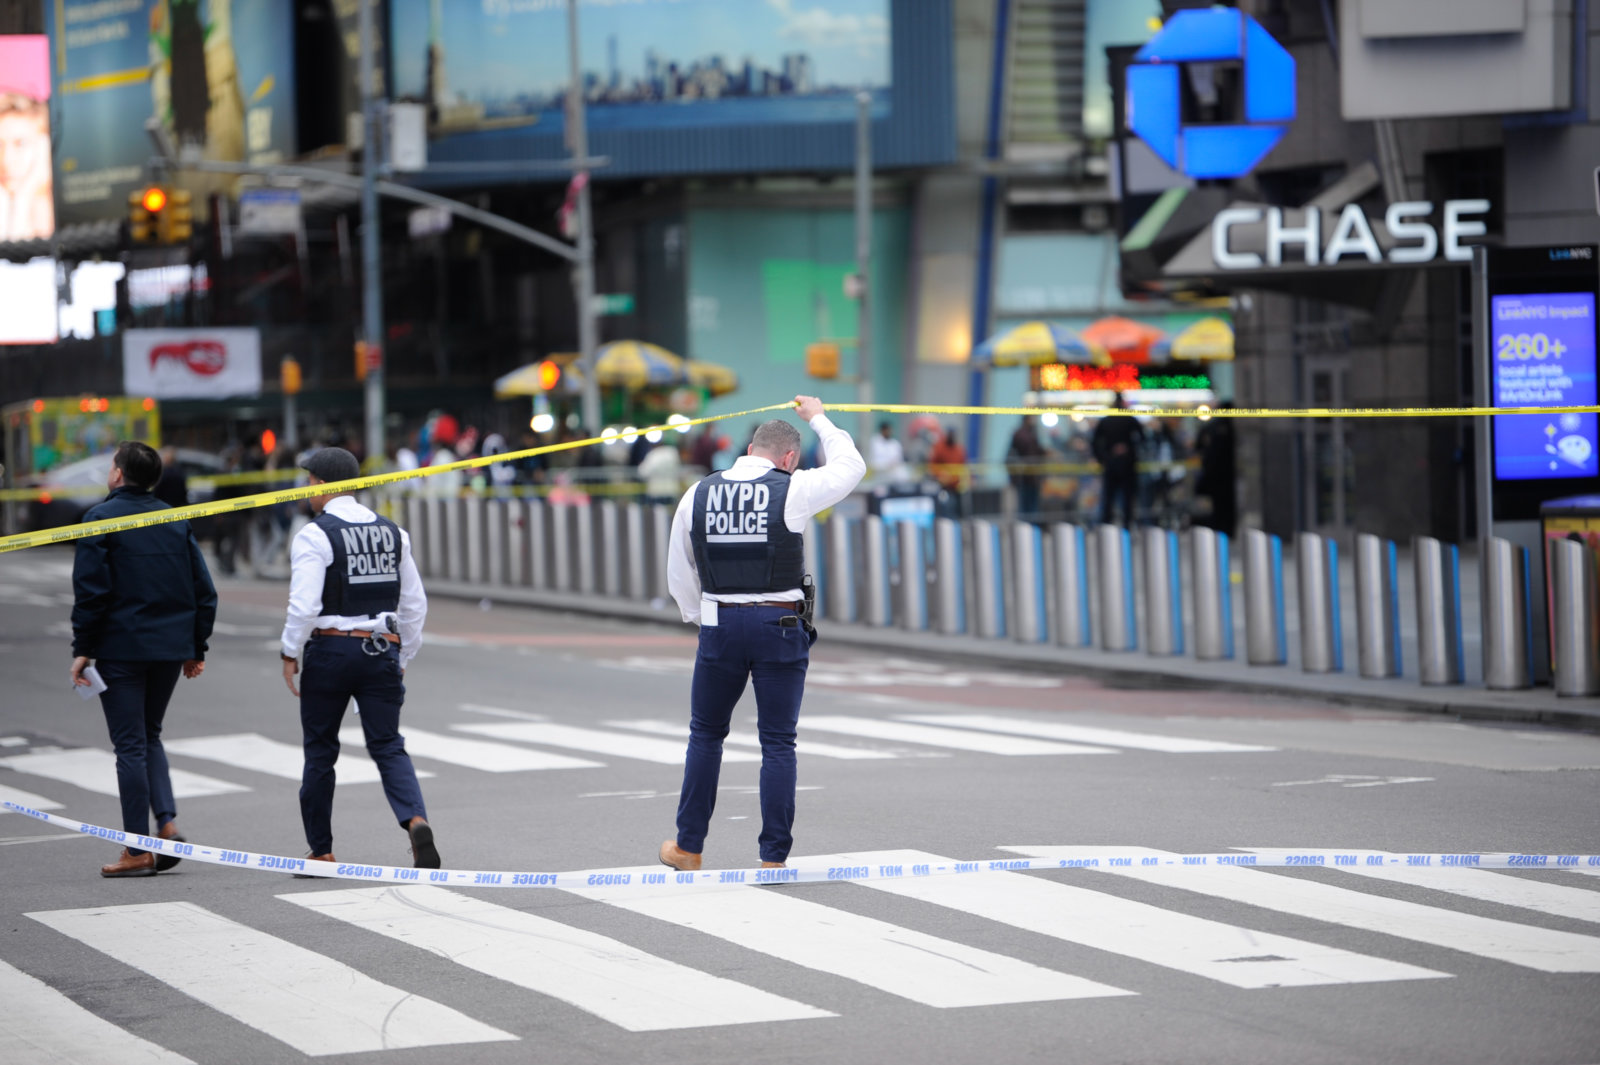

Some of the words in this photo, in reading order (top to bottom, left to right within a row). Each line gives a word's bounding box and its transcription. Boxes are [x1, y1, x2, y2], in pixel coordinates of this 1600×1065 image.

[1212, 199, 1490, 269] CHASE
[1497, 333, 1567, 361] 260+
[706, 483, 770, 511] NYPD
[705, 511, 769, 534] POLICE
[340, 525, 395, 554] NYPD
[347, 552, 397, 576] POLICE
